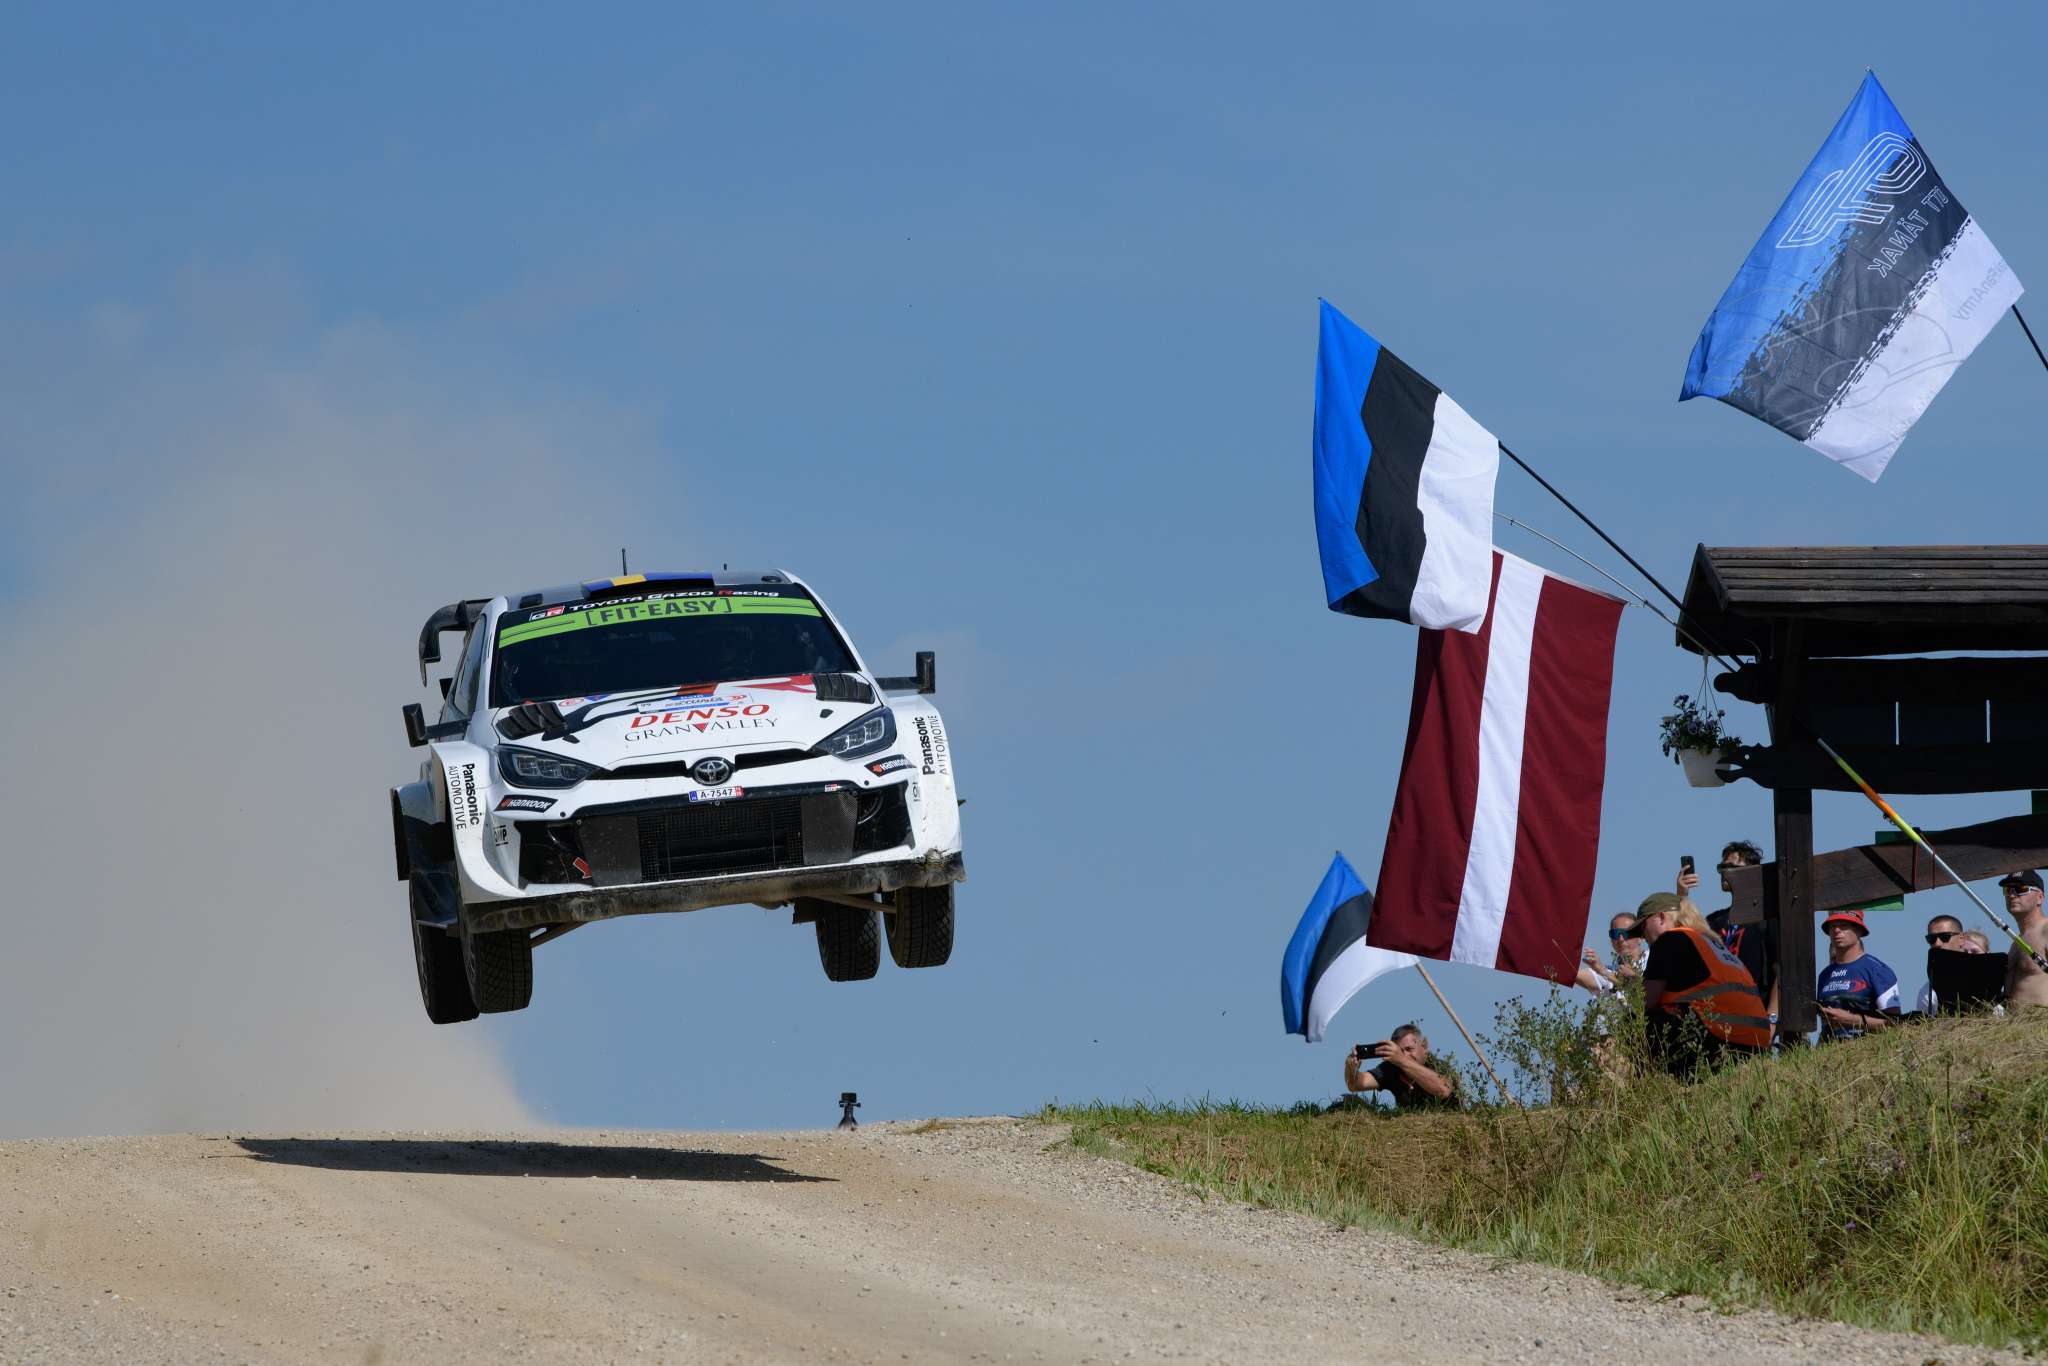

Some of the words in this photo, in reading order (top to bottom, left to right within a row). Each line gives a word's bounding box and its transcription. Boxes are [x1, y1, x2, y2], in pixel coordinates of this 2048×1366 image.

[569, 596, 643, 611] TOYOTA
[648, 590, 713, 600] GAZOO
[718, 588, 779, 597] Racing
[630, 704, 770, 729] DENSO
[912, 717, 935, 775] Panasonic
[448, 766, 467, 830] AUTOMOTIVE
[462, 763, 483, 825] Panasonic
[700, 788, 733, 799] A-7547
